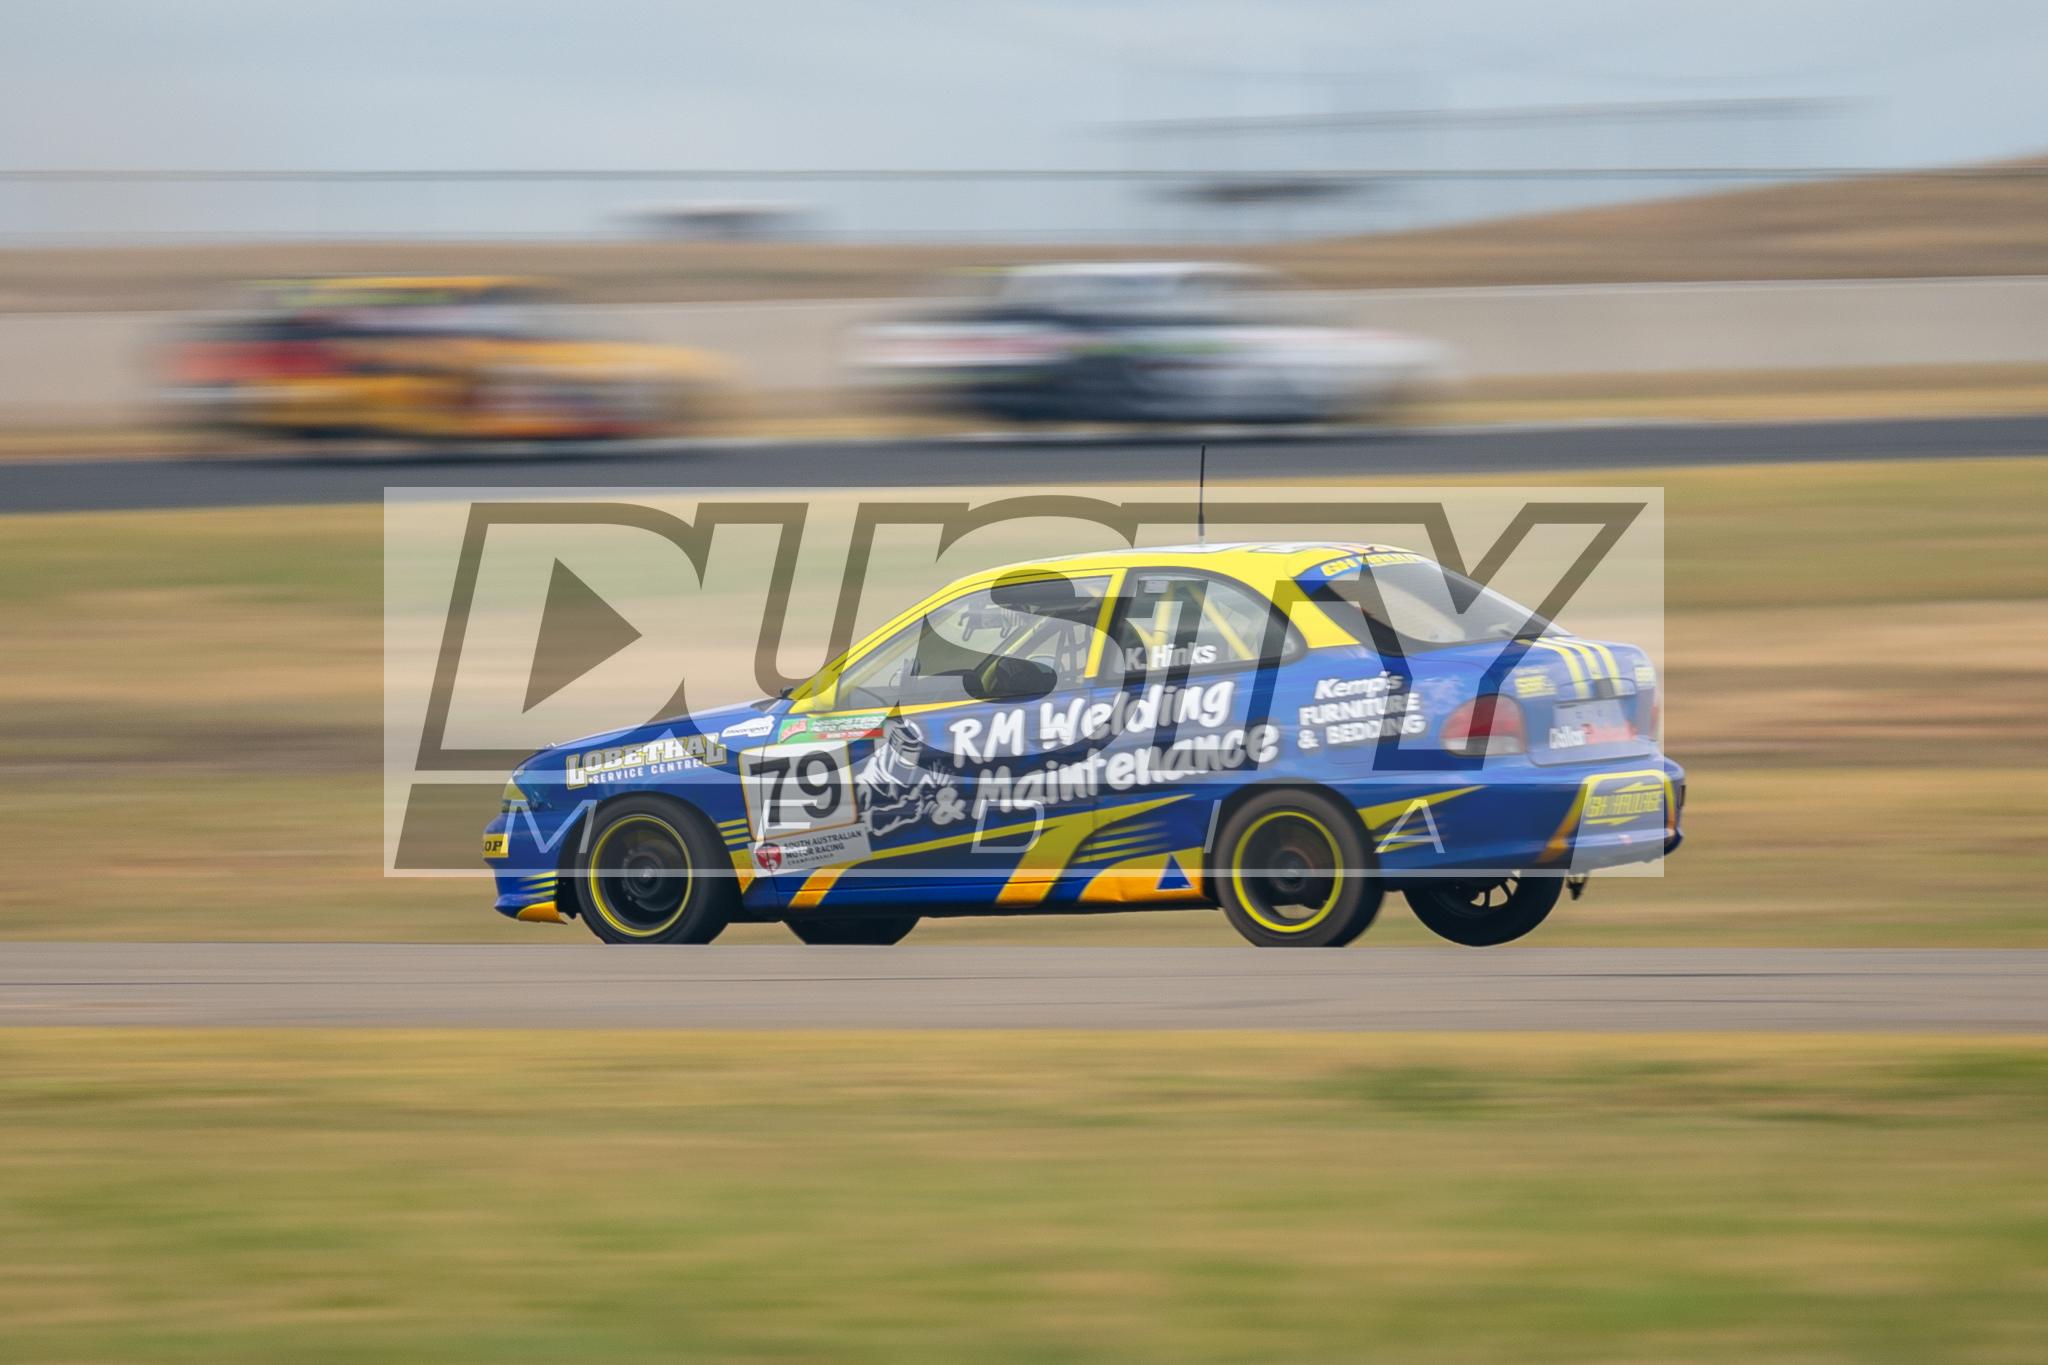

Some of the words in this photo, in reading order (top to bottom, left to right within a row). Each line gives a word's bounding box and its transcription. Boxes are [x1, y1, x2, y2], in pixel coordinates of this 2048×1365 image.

[1125, 647, 1146, 670] K.
[1151, 643, 1217, 668] Hinks
[1314, 671, 1404, 699] Kemp's
[949, 708, 1025, 768] RM
[1039, 681, 1235, 749] Welding
[1298, 692, 1420, 726] FURNITURE
[1298, 729, 1319, 749] &
[1326, 714, 1427, 745] BEDDING
[565, 732, 728, 790] LOBETHAL
[592, 767, 645, 784] SERVICE
[651, 757, 699, 775] CENTRE
[931, 786, 966, 825] &
[971, 724, 1280, 819] Maintenance
[749, 750, 842, 827] 79
[784, 839, 811, 849] SOUTH
[811, 831, 862, 846] AUSTRALIAN
[785, 848, 813, 859] MOTOR
[812, 843, 845, 856] RACING
